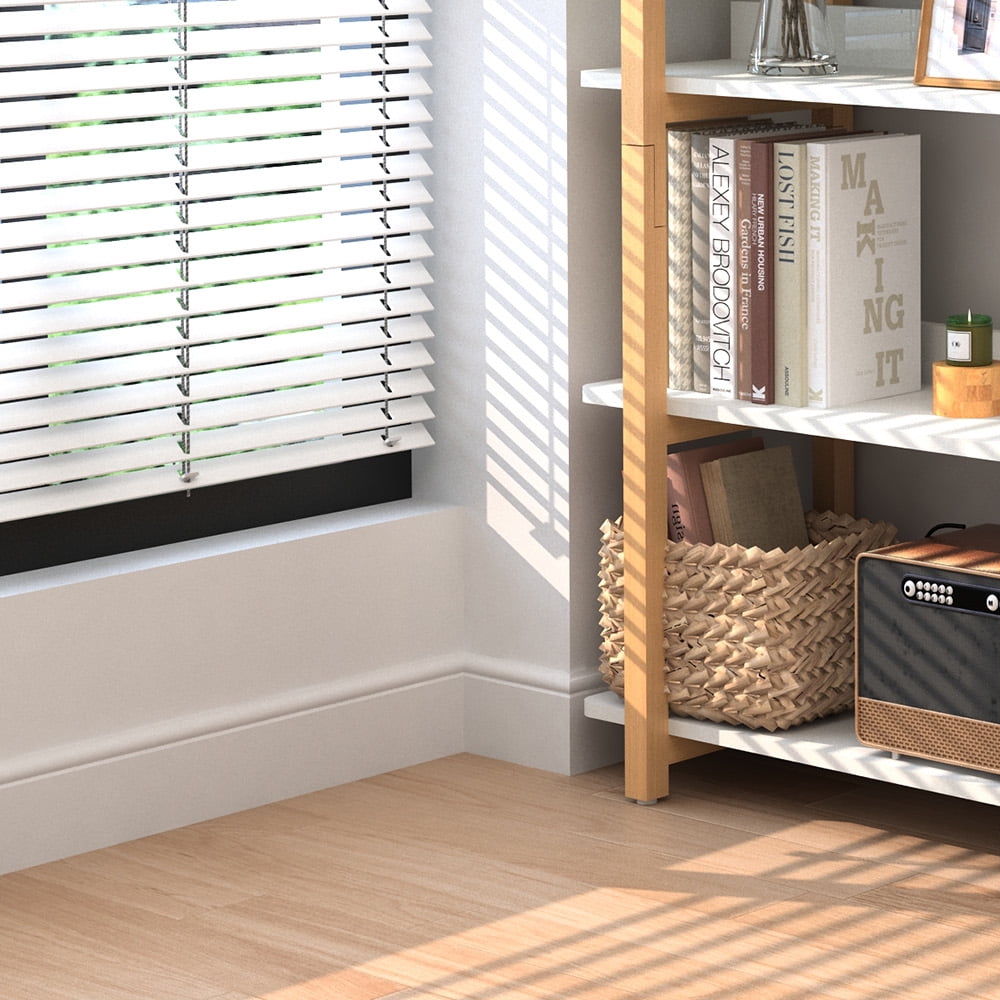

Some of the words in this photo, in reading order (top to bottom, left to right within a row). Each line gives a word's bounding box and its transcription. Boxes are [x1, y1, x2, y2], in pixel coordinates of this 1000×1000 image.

[711, 144, 730, 232] ALEXEY
[757, 193, 765, 212] NEW
[778, 152, 795, 208] LOST
[809, 156, 821, 221] MAKING
[740, 218, 751, 269] Gardens
[757, 214, 765, 248] URBAN
[778, 214, 795, 264] FISH
[810, 223, 821, 242] IT
[741, 271, 750, 285] in
[757, 250, 765, 291] HOUSING
[711, 238, 731, 382] BRODOVITCH
[742, 288, 751, 331] France
